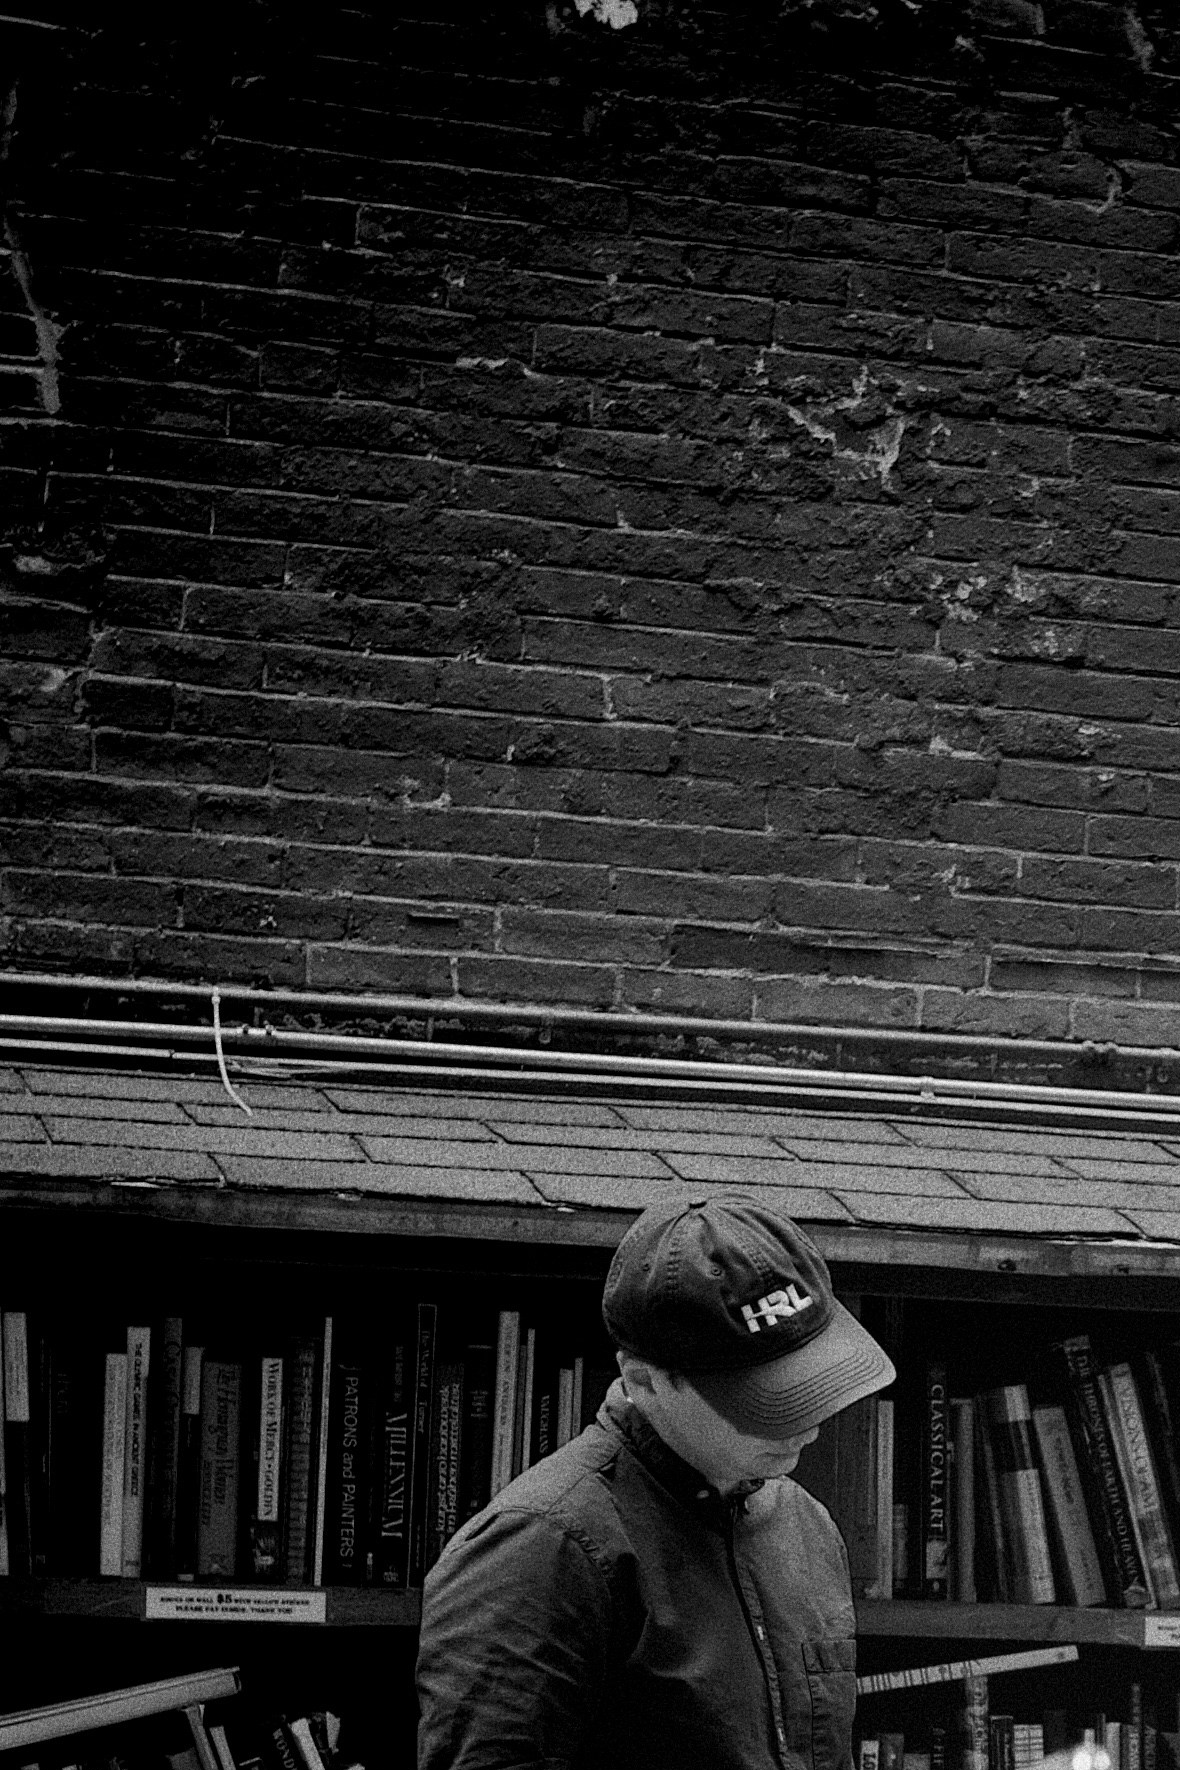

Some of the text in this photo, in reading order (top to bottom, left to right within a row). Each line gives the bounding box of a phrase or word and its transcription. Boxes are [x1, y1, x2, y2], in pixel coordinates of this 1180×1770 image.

[740, 1283, 814, 1334] HRL
[265, 1361, 281, 1400] WORK
[265, 1400, 277, 1419] OF
[264, 1420, 280, 1462] MERCY
[929, 1383, 945, 1533] CLASSICAL ART
[339, 1375, 359, 1558] PATRONS and PAINTERS
[381, 1410, 408, 1539] MILLENNIUM
[216, 1593, 233, 1604] $5
